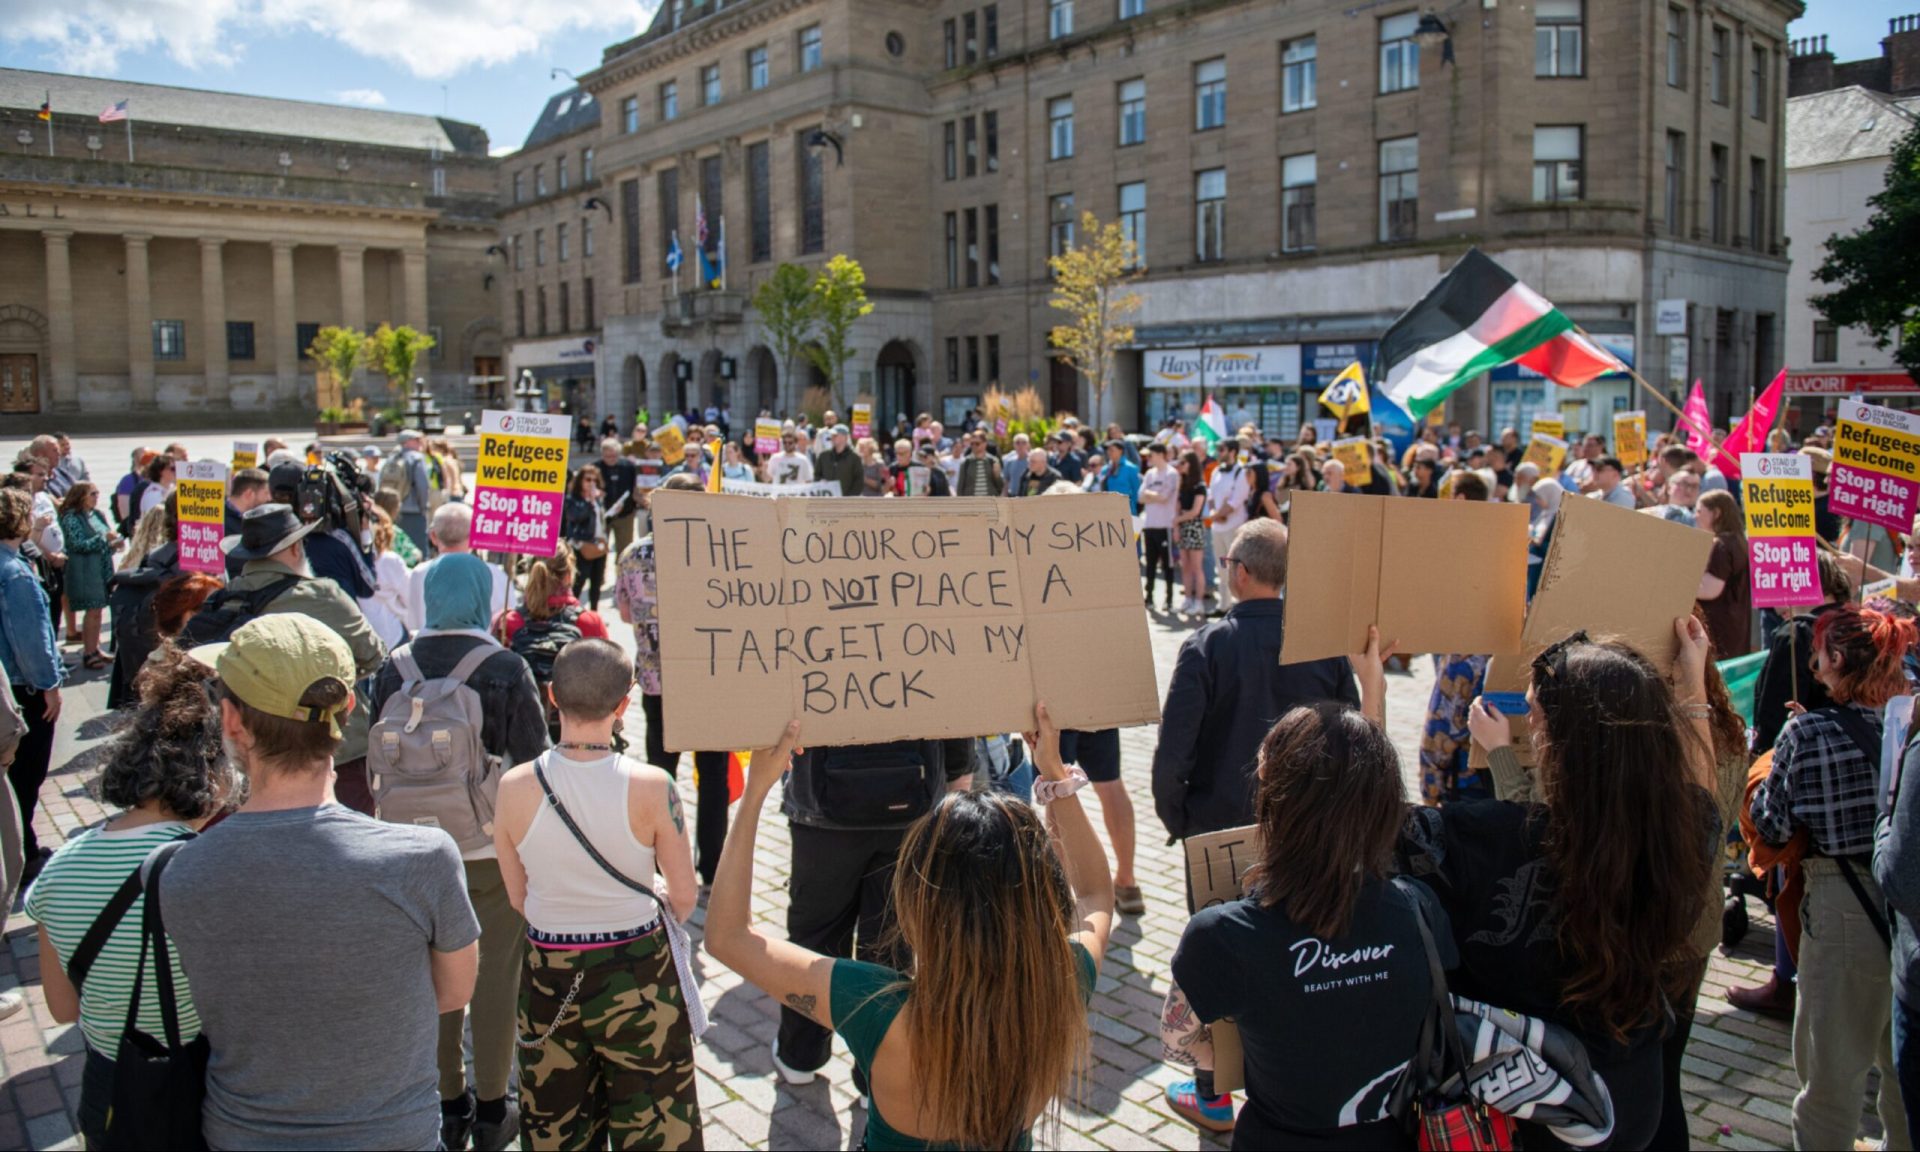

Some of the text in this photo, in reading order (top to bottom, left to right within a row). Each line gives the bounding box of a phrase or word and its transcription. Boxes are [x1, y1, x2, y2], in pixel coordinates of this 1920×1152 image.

[1159, 353, 1263, 374] Hays Travel
[1785, 376, 1846, 392] ELVOIR!
[516, 416, 538, 425] STAND
[1872, 409, 1896, 421] STAND
[526, 425, 552, 434] RACISM
[1841, 424, 1920, 456] Refugees
[485, 438, 564, 463] Refugees
[1839, 446, 1915, 474] welcome
[483, 462, 557, 484] welcome
[1836, 467, 1908, 499] Stop the
[180, 483, 222, 503] Refugees
[478, 491, 552, 517] Stop the
[1749, 483, 1812, 508] Refugees
[1833, 486, 1859, 505] far
[1862, 494, 1905, 520] right
[180, 501, 220, 518] welcome
[1751, 508, 1811, 528] welcome
[181, 524, 218, 544] Stop the
[476, 513, 548, 541] far right
[181, 542, 218, 563] far right
[663, 518, 1127, 571] THE COLOUR OF MY SKIN
[1753, 542, 1810, 567] Stop the
[706, 564, 1072, 608] SHOULD NOT PLACE A
[1755, 567, 1812, 592] far right
[695, 623, 1024, 676] TARGET ON MY
[802, 669, 935, 714] BACK
[1204, 840, 1244, 891] IT
[1289, 938, 1394, 978] Discover
[1304, 971, 1389, 993] BEAUTY WITH ME
